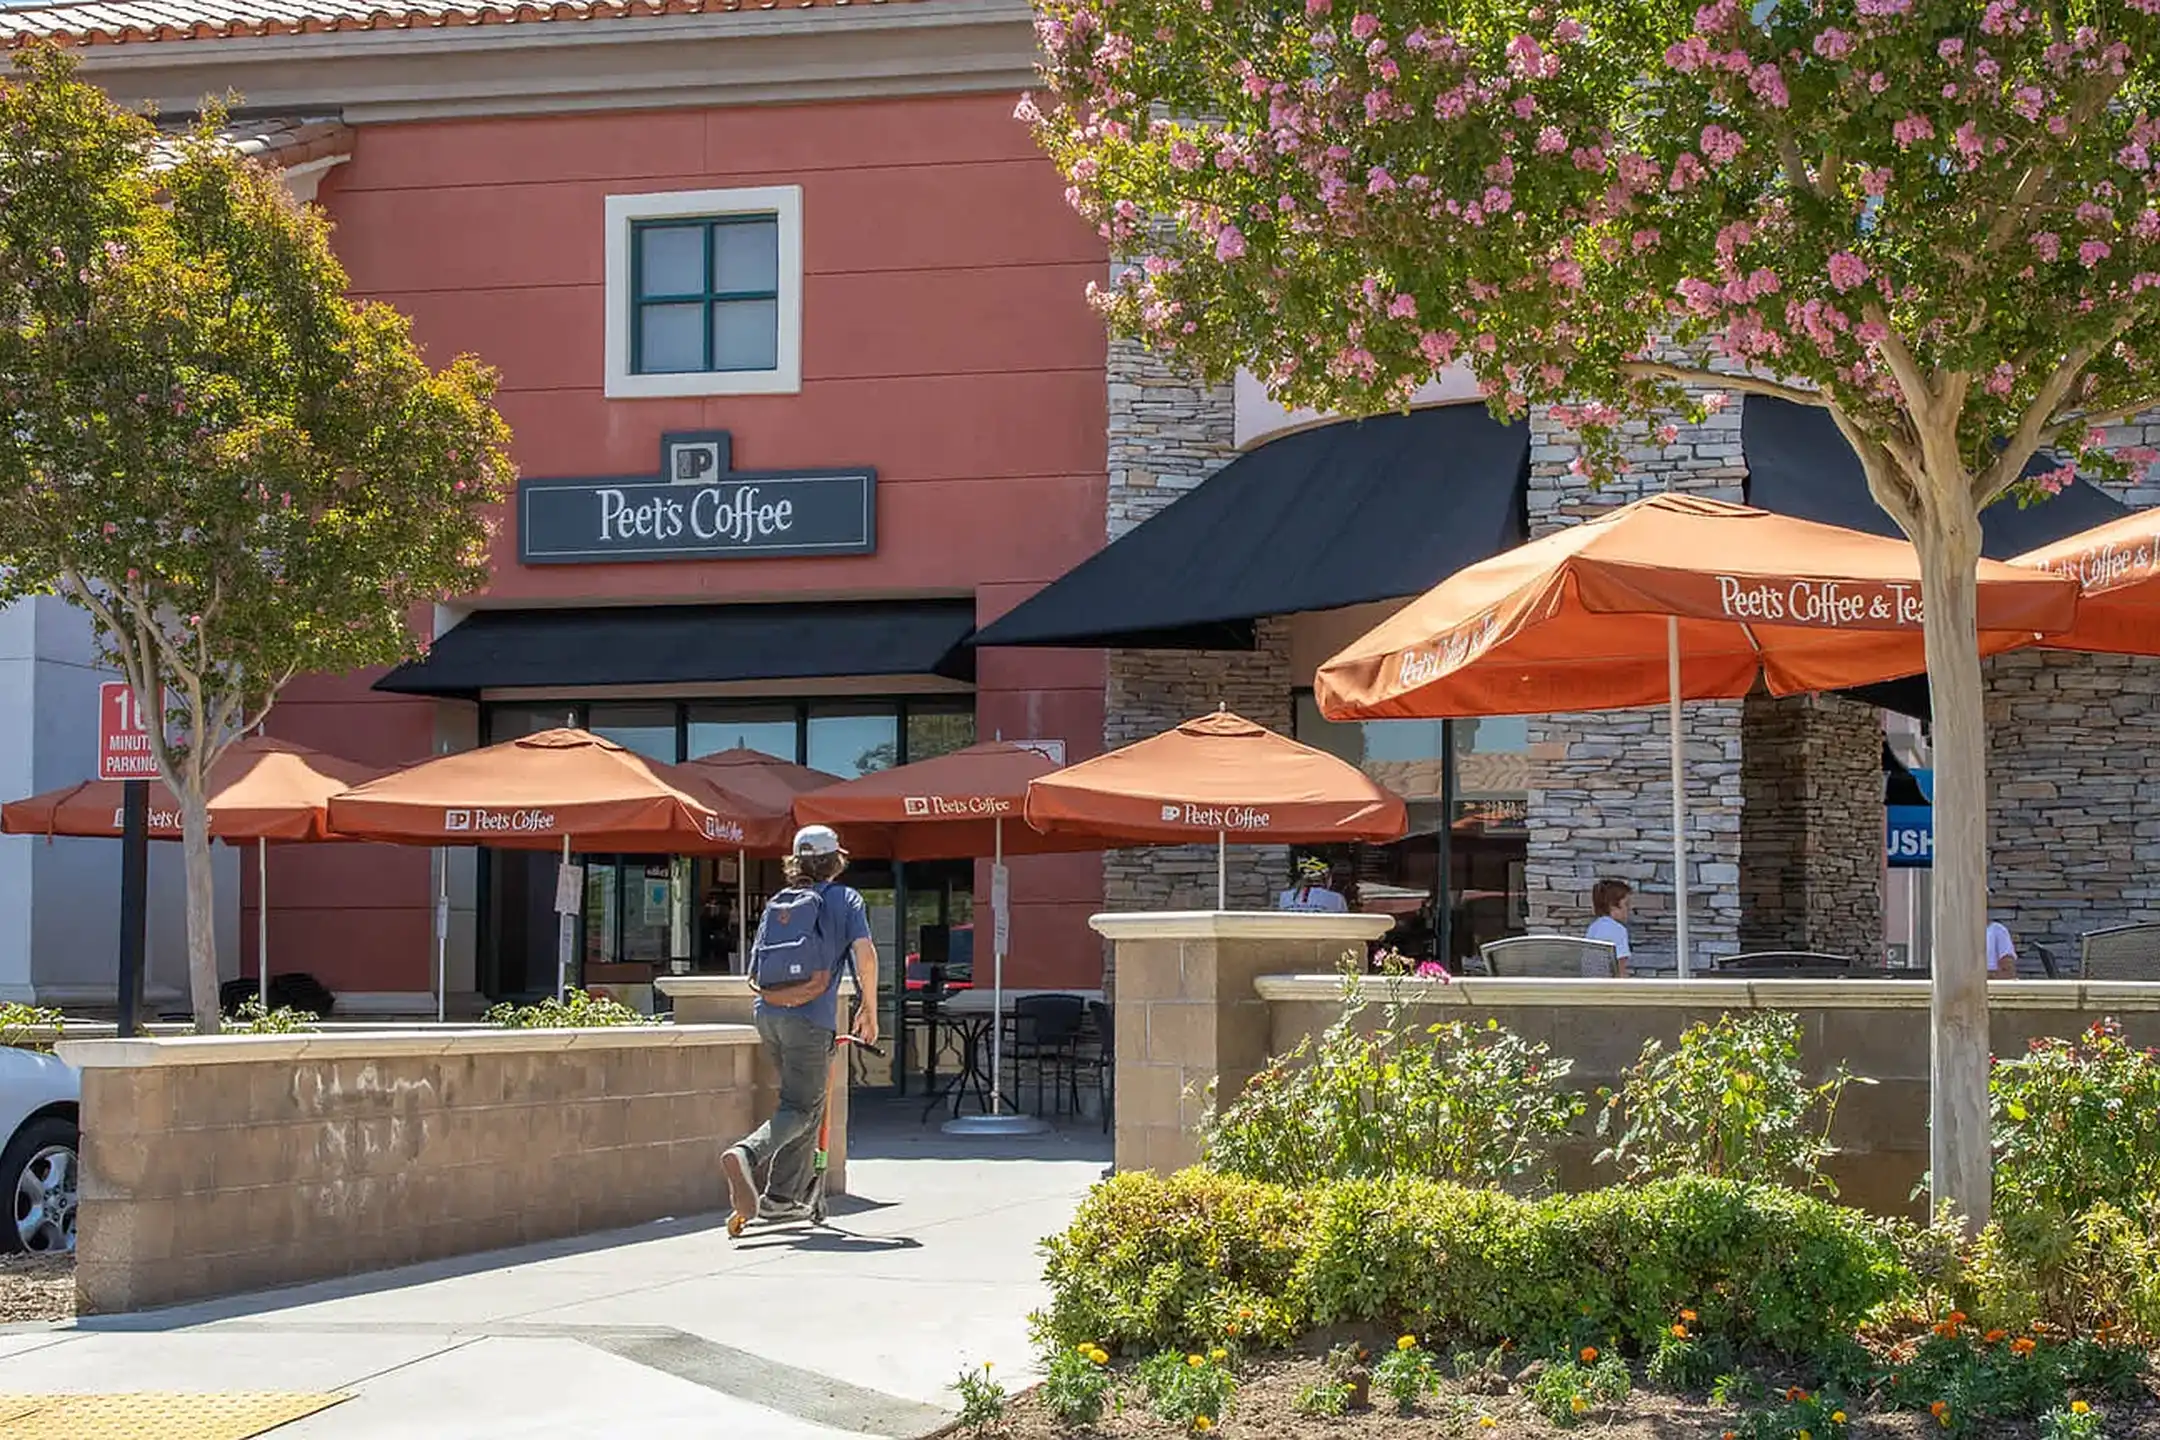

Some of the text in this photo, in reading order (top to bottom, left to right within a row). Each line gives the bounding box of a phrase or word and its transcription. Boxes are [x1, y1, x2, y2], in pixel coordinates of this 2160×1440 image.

[596, 486, 792, 542] Peet's Coffee
[2080, 543, 2131, 588] Coffee
[1715, 576, 1784, 618] Peet's
[1789, 582, 1865, 626] Coffee
[1869, 595, 1891, 619] &
[106, 756, 157, 772] PARKING
[969, 796, 1010, 815] Coffee
[512, 809, 554, 831] Coffee
[1225, 806, 1270, 829] Coffee
